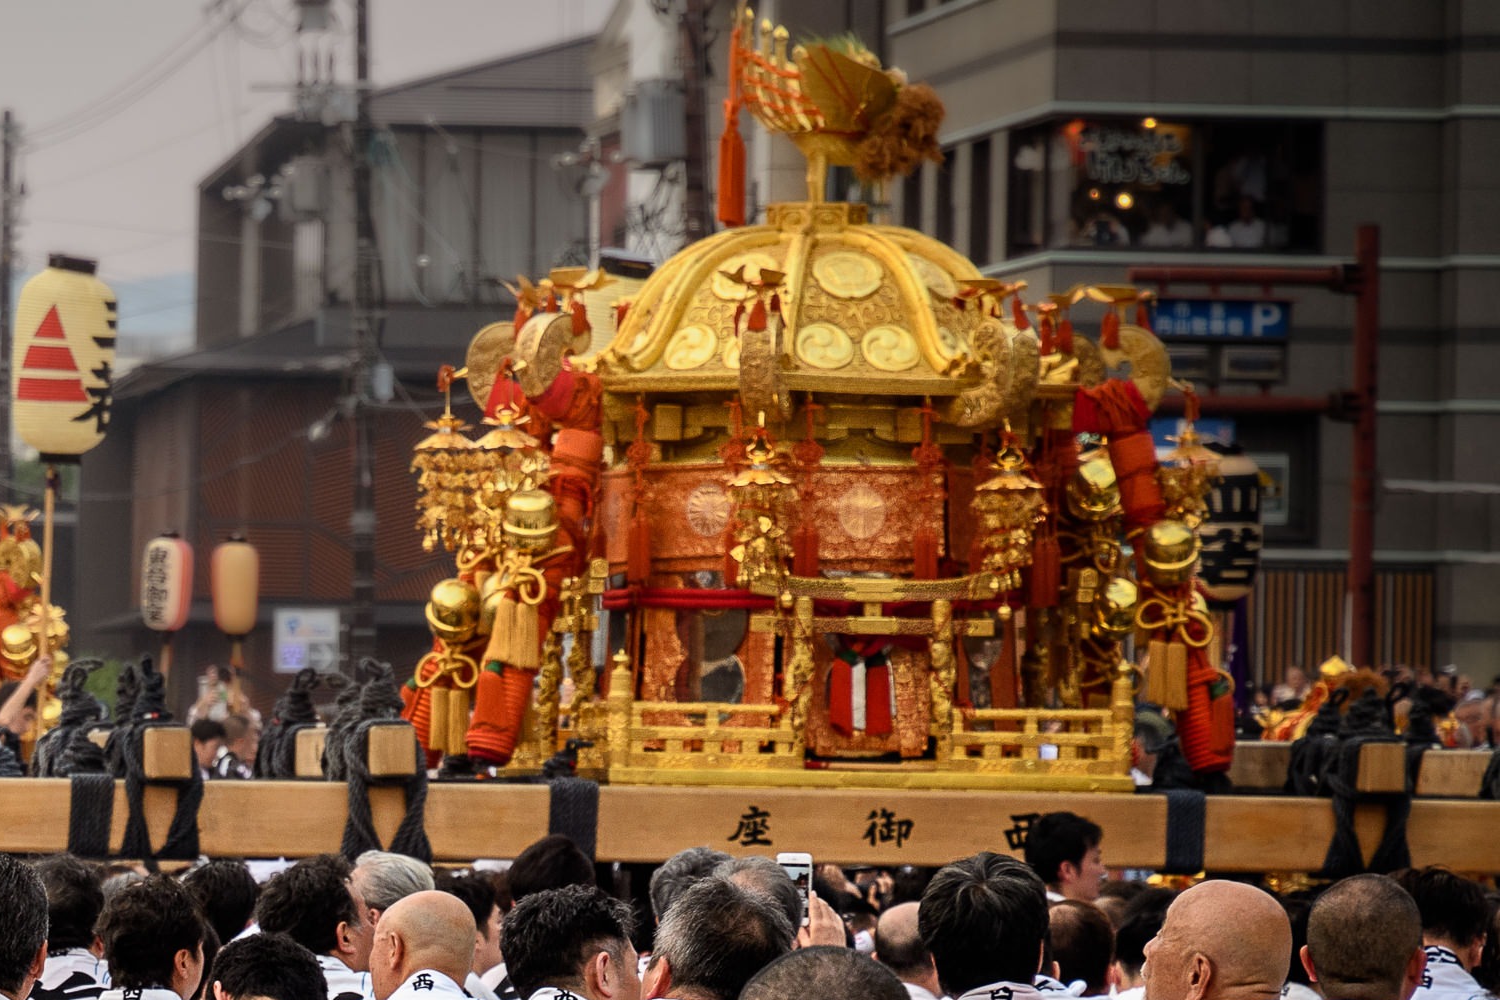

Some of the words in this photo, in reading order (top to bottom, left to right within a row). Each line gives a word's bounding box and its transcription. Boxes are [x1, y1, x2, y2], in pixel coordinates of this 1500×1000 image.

[1251, 303, 1282, 337] P
[727, 805, 773, 847] 座
[862, 807, 915, 849] 御
[412, 973, 434, 991] 西
